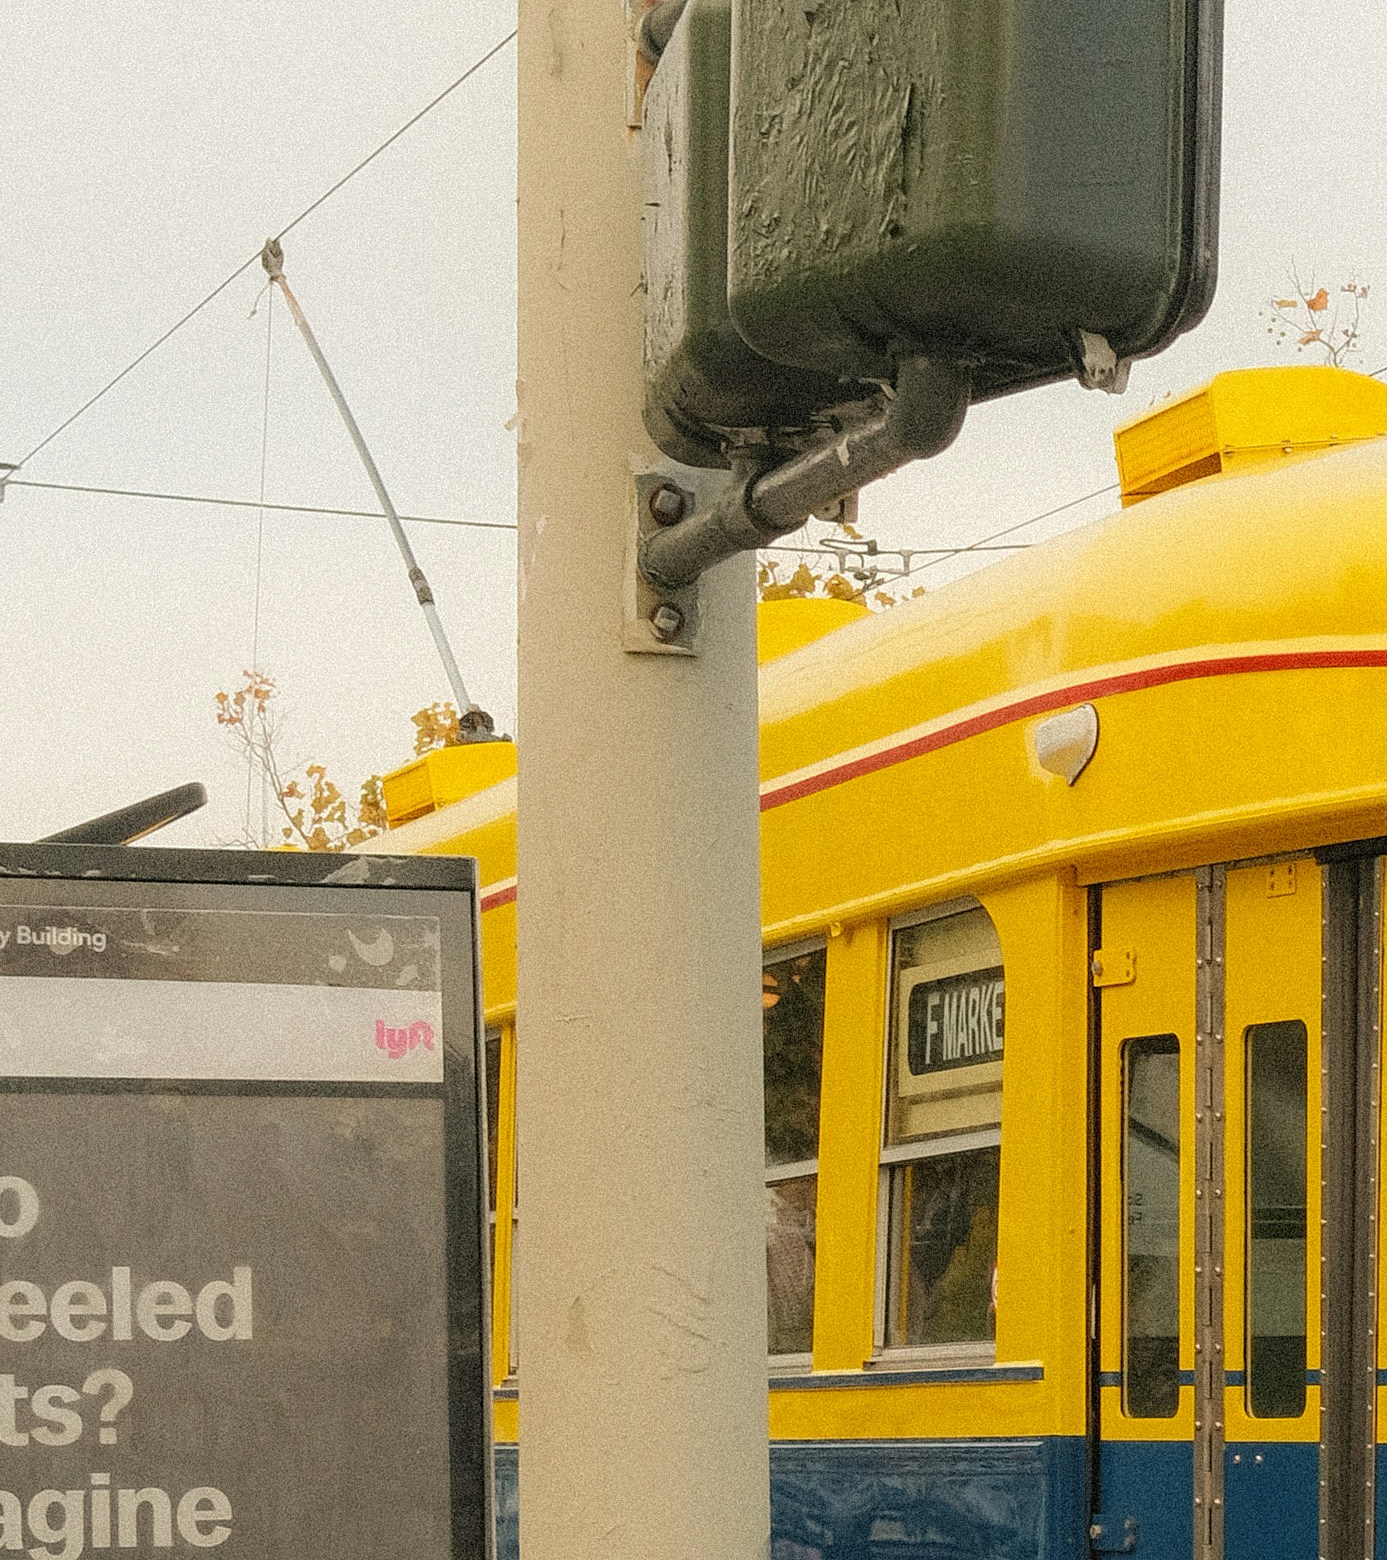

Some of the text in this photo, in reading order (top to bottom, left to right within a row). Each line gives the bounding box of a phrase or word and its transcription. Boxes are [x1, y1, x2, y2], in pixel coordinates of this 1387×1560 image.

[17, 925, 106, 952] Building
[375, 1019, 435, 1059] lyft
[925, 991, 940, 1064] F
[0, 1266, 253, 1341] eeled
[0, 1368, 134, 1447] ts?
